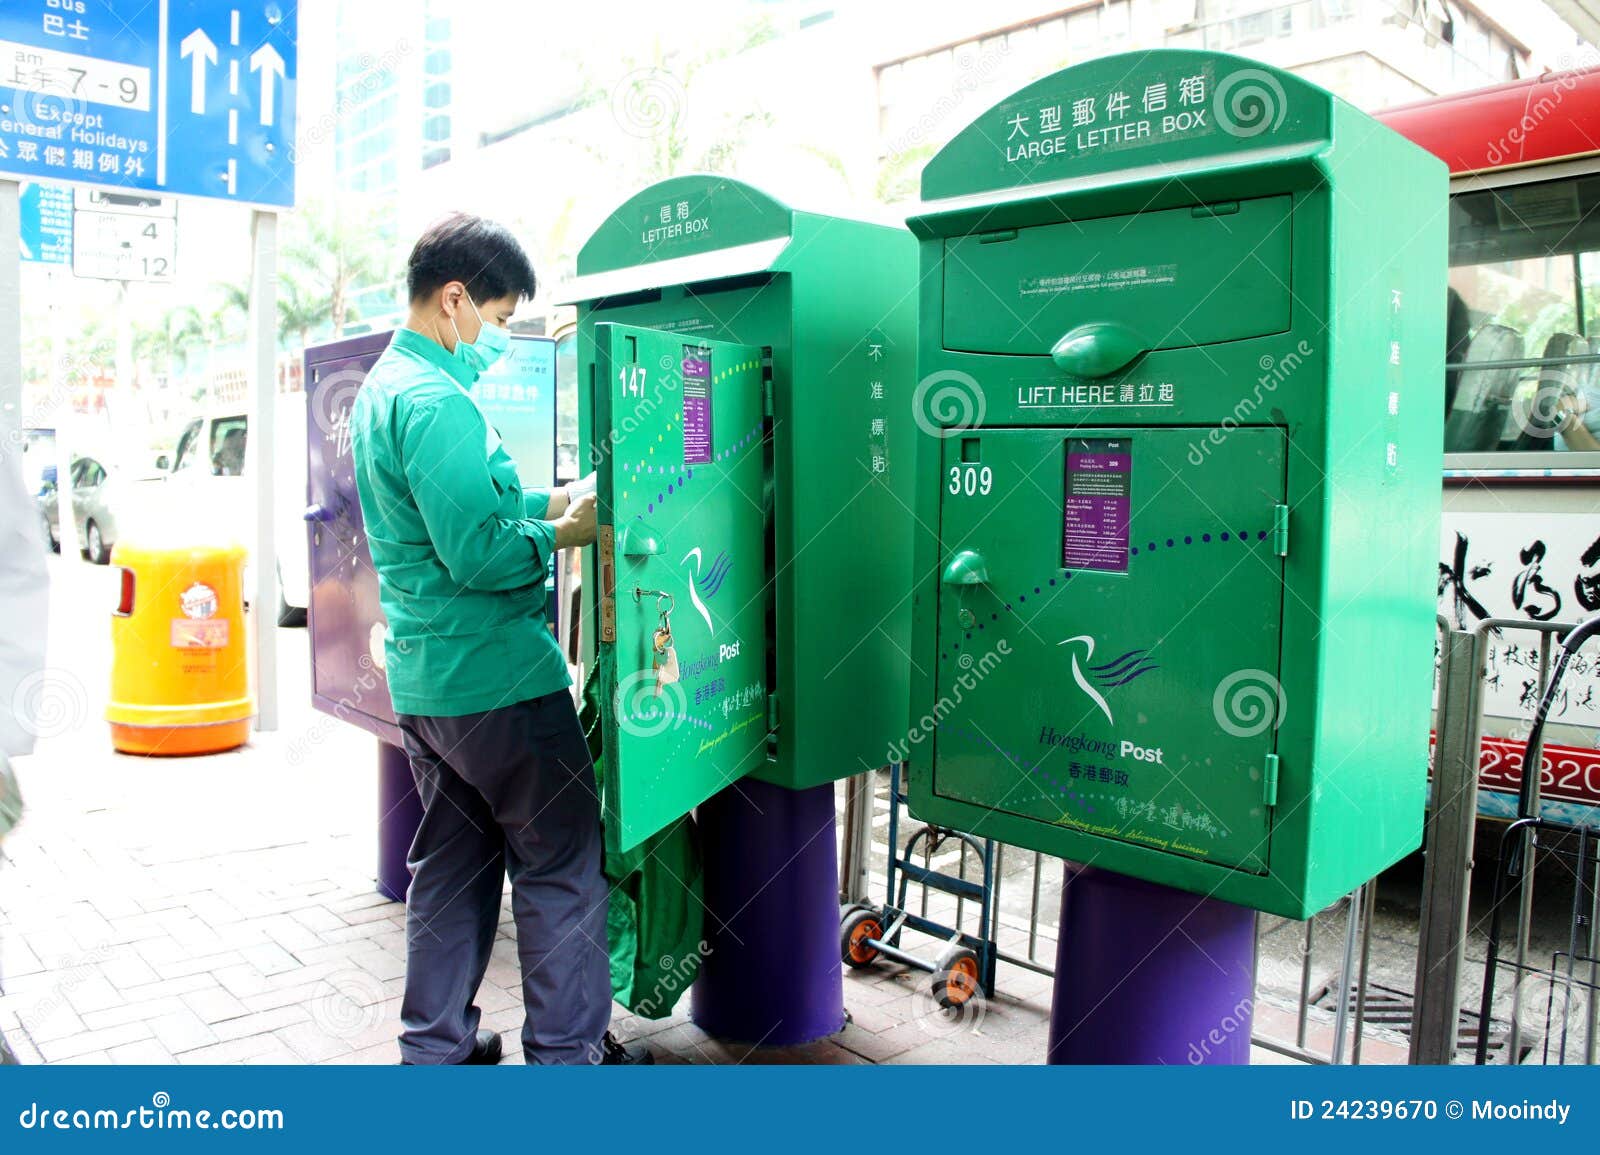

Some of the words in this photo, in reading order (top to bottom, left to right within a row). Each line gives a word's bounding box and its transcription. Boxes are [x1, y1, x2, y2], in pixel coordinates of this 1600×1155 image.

[43, 13, 90, 40] 巴士
[14, 51, 43, 66] am
[6, 65, 53, 88] 上午
[67, 67, 87, 94] 7
[119, 77, 138, 104] 9
[35, 103, 103, 129] Except
[1007, 75, 1206, 142] 大型郵件信箱
[0, 119, 62, 140] eneral
[71, 127, 148, 153] Holidays
[1006, 136, 1067, 162] LARGE
[1077, 120, 1151, 149] LETTER
[1161, 109, 1207, 134] BOX
[660, 201, 690, 224] 信箱
[142, 222, 159, 239] 4
[642, 224, 683, 244] LETTER
[685, 217, 709, 234] BOX
[142, 257, 168, 277] 12
[619, 366, 647, 398] 147
[1386, 288, 1403, 467] 不准標貼
[1018, 386, 1055, 404] LIFT
[1062, 385, 1115, 403] HERE
[1119, 383, 1174, 402] 請拉起
[867, 344, 885, 473] 不准標貼
[949, 465, 993, 497] 309
[719, 639, 741, 664] Post
[695, 677, 725, 705] 香港郵政
[1039, 726, 1118, 761] Hongkong
[1120, 740, 1164, 765] Post
[1069, 761, 1130, 788] 香港郵政
